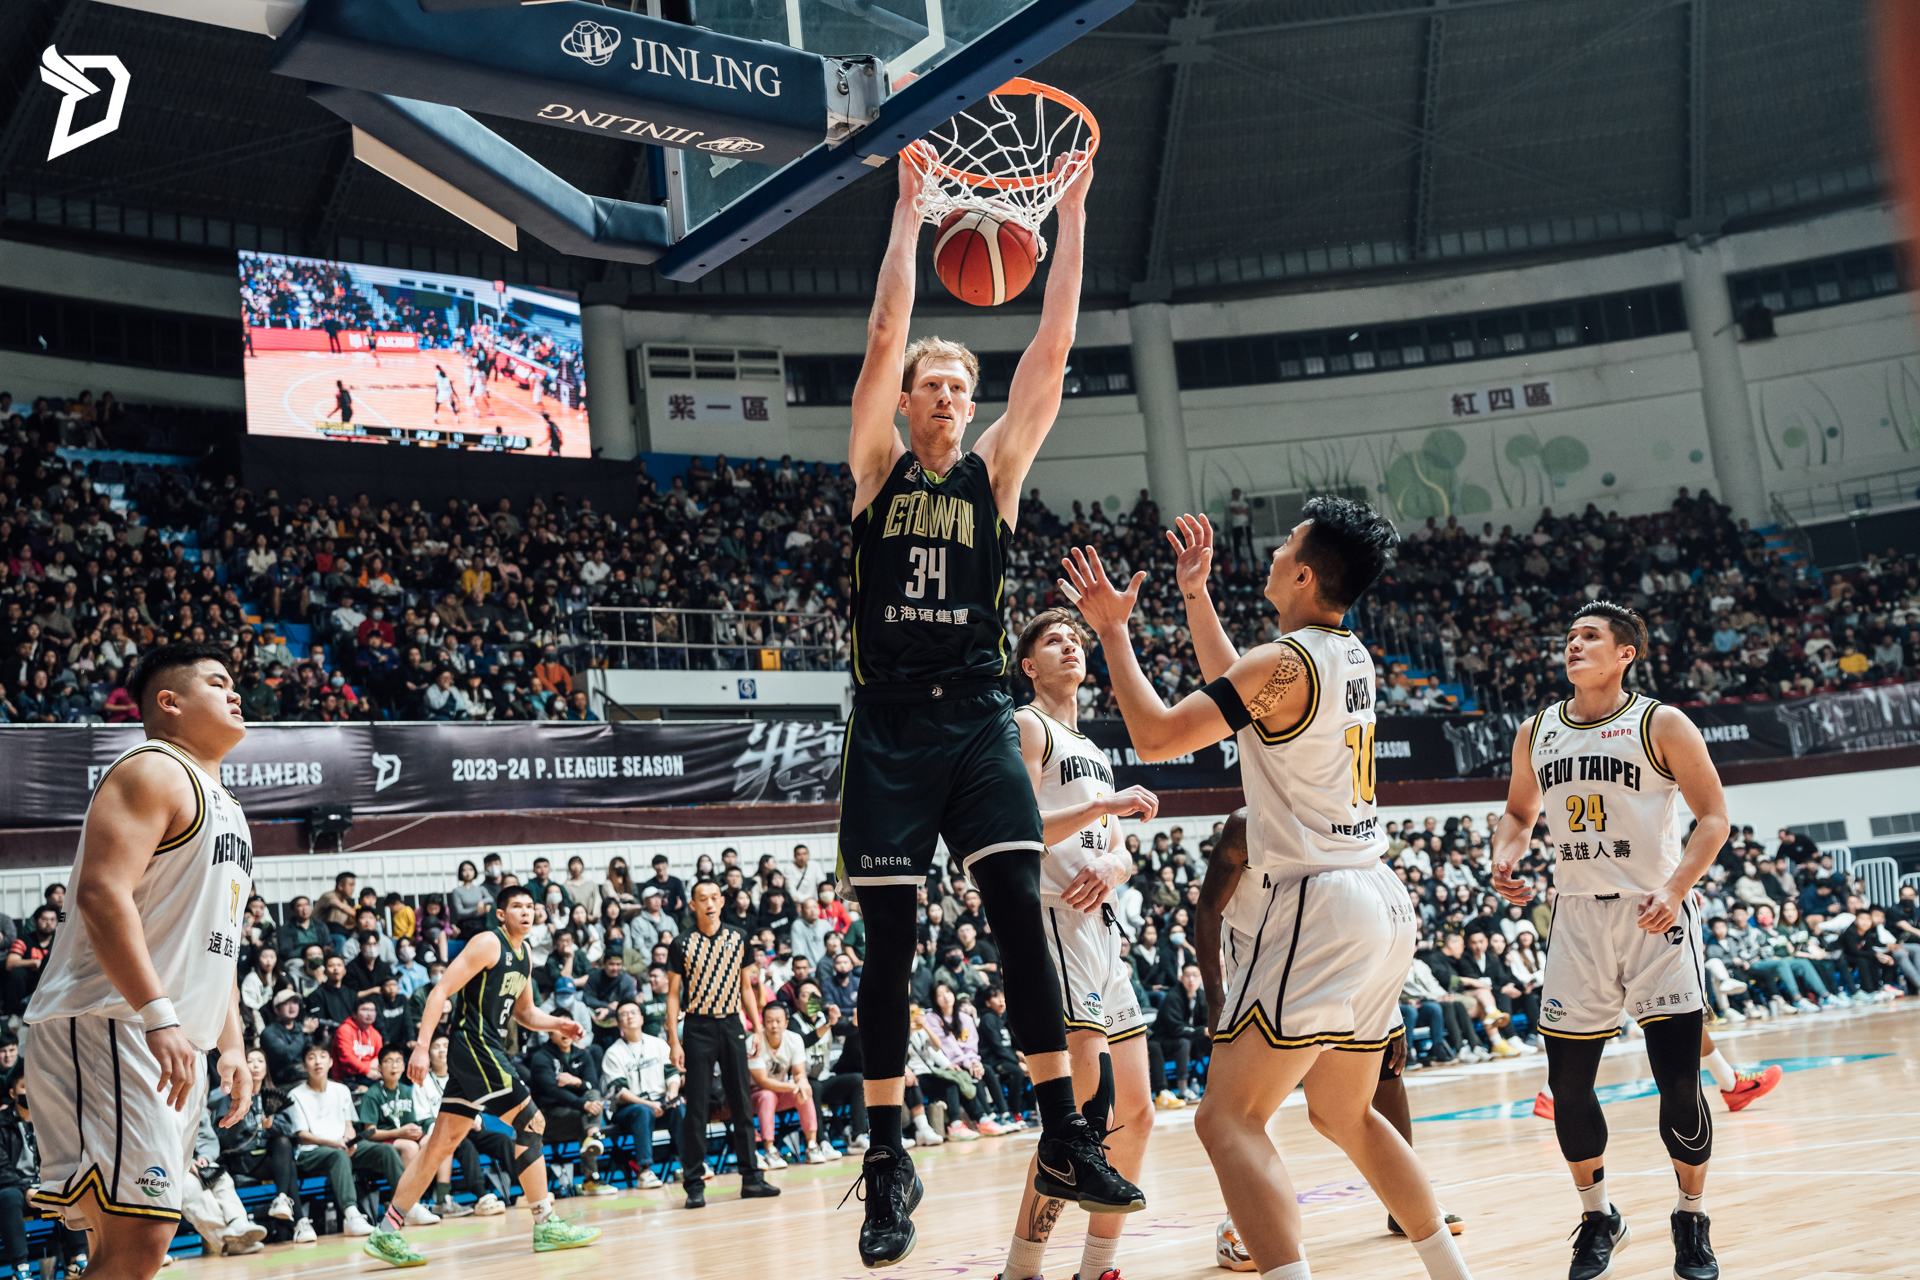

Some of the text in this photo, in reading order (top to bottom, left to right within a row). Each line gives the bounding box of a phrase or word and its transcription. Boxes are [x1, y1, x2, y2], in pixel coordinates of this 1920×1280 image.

[631, 37, 782, 97] JINLING
[537, 104, 705, 144] JINLING
[669, 394, 769, 421] 紫一區
[1452, 382, 1552, 416] 紅四區
[905, 546, 947, 600] 34
[1601, 728, 1632, 739] SAMPO
[222, 762, 322, 787] REAMERS
[452, 758, 530, 782] 2023-24
[622, 755, 684, 777] SEASON
[1060, 756, 1091, 786] NEW
[1345, 722, 1375, 808] 10
[1538, 755, 1641, 796] NEW TAIPEI
[1566, 794, 1607, 832] 24
[1559, 840, 1631, 861] 遠雄人壽
[231, 879, 240, 927] 11
[150, 1179, 170, 1188] Eagle
